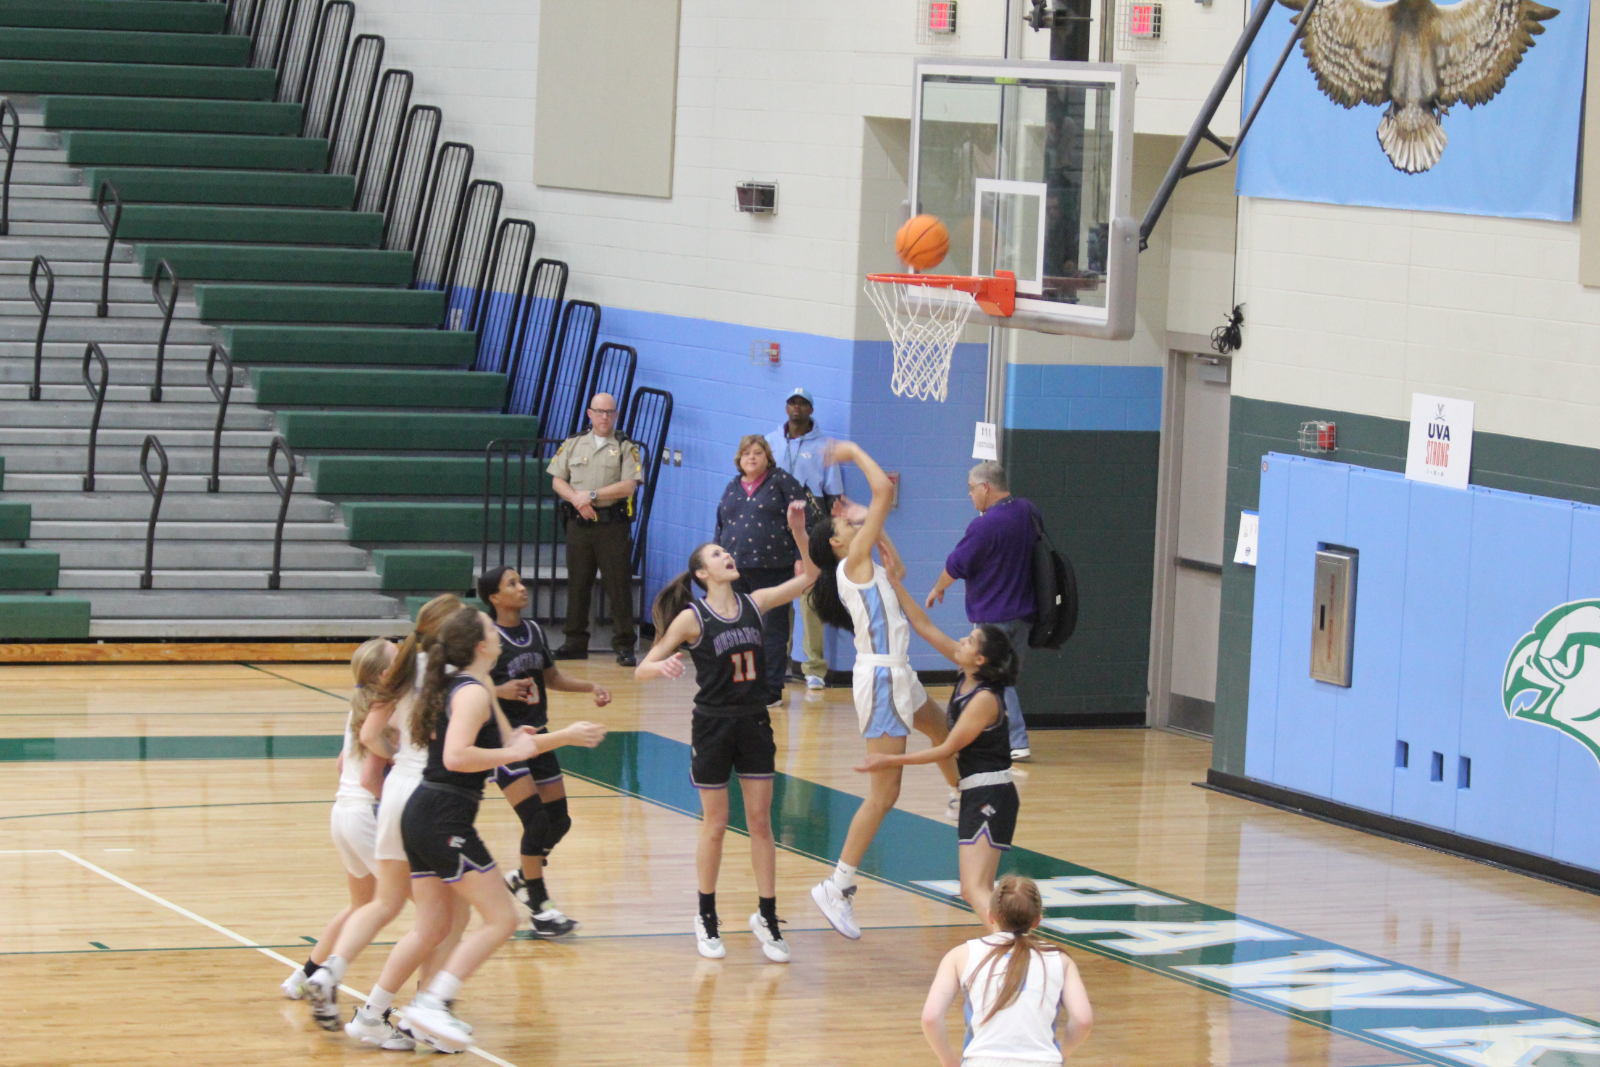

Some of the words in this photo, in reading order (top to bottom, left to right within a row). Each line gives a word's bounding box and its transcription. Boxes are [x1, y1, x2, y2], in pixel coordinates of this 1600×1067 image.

[1428, 423, 1450, 441] UVA
[1426, 440, 1450, 467] STRONG
[731, 650, 757, 683] 11
